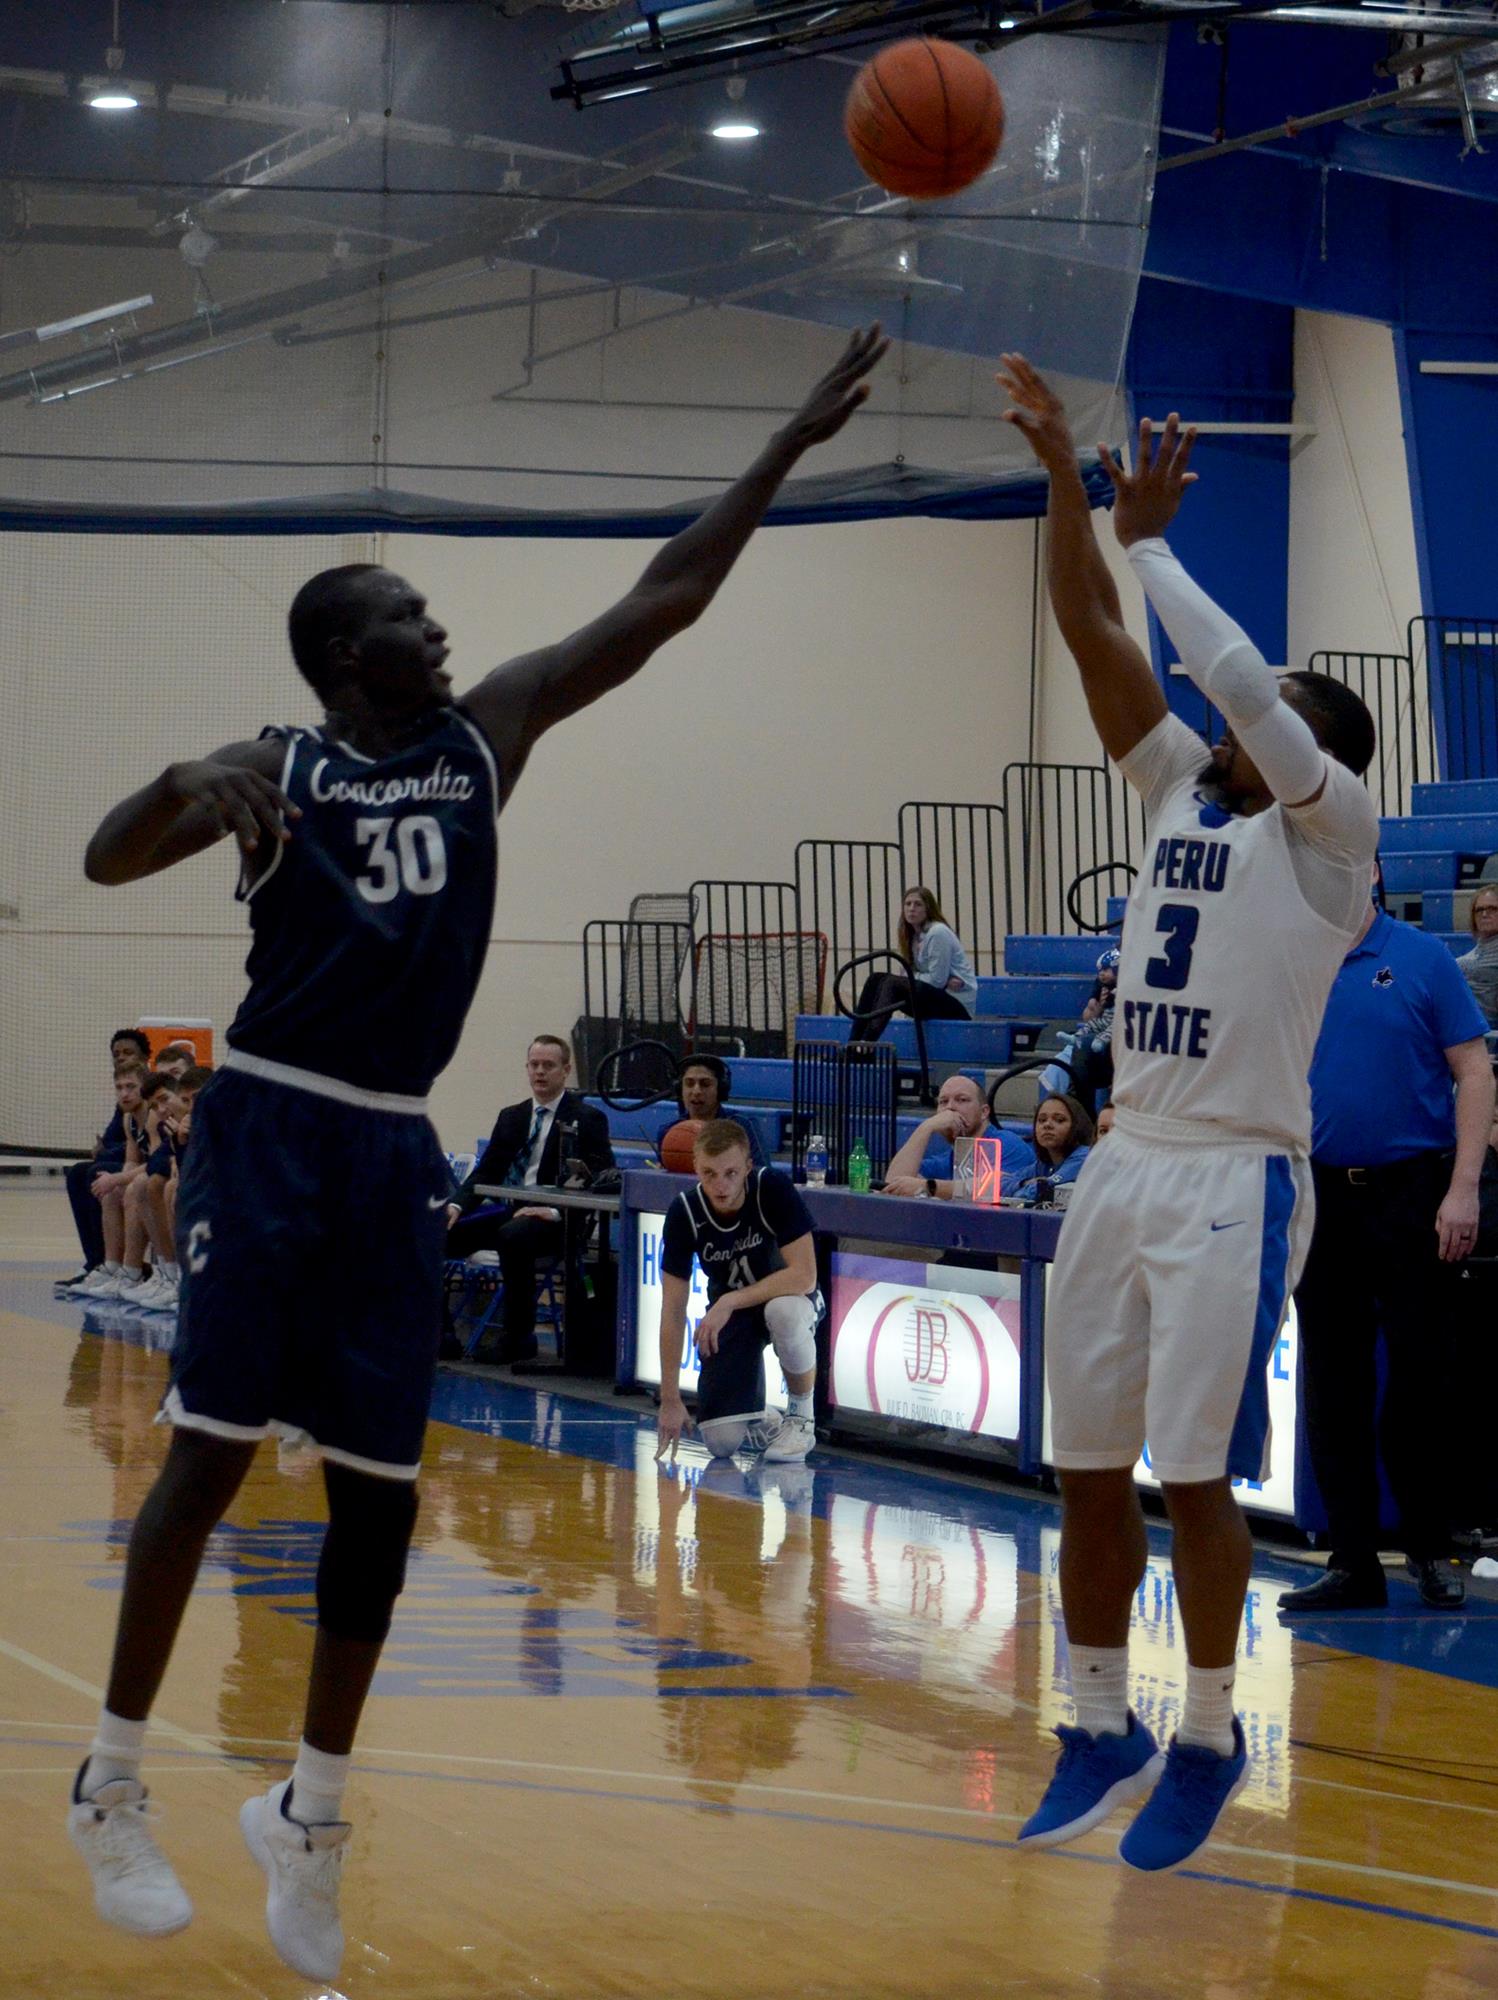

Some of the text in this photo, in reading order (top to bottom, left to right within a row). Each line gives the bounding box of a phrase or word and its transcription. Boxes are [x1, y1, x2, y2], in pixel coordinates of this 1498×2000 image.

[309, 755, 475, 806] Concordia
[355, 814, 448, 903] 30
[1152, 838, 1231, 892] PERU
[1145, 903, 1199, 991] 3
[1124, 1000, 1211, 1058] STATE
